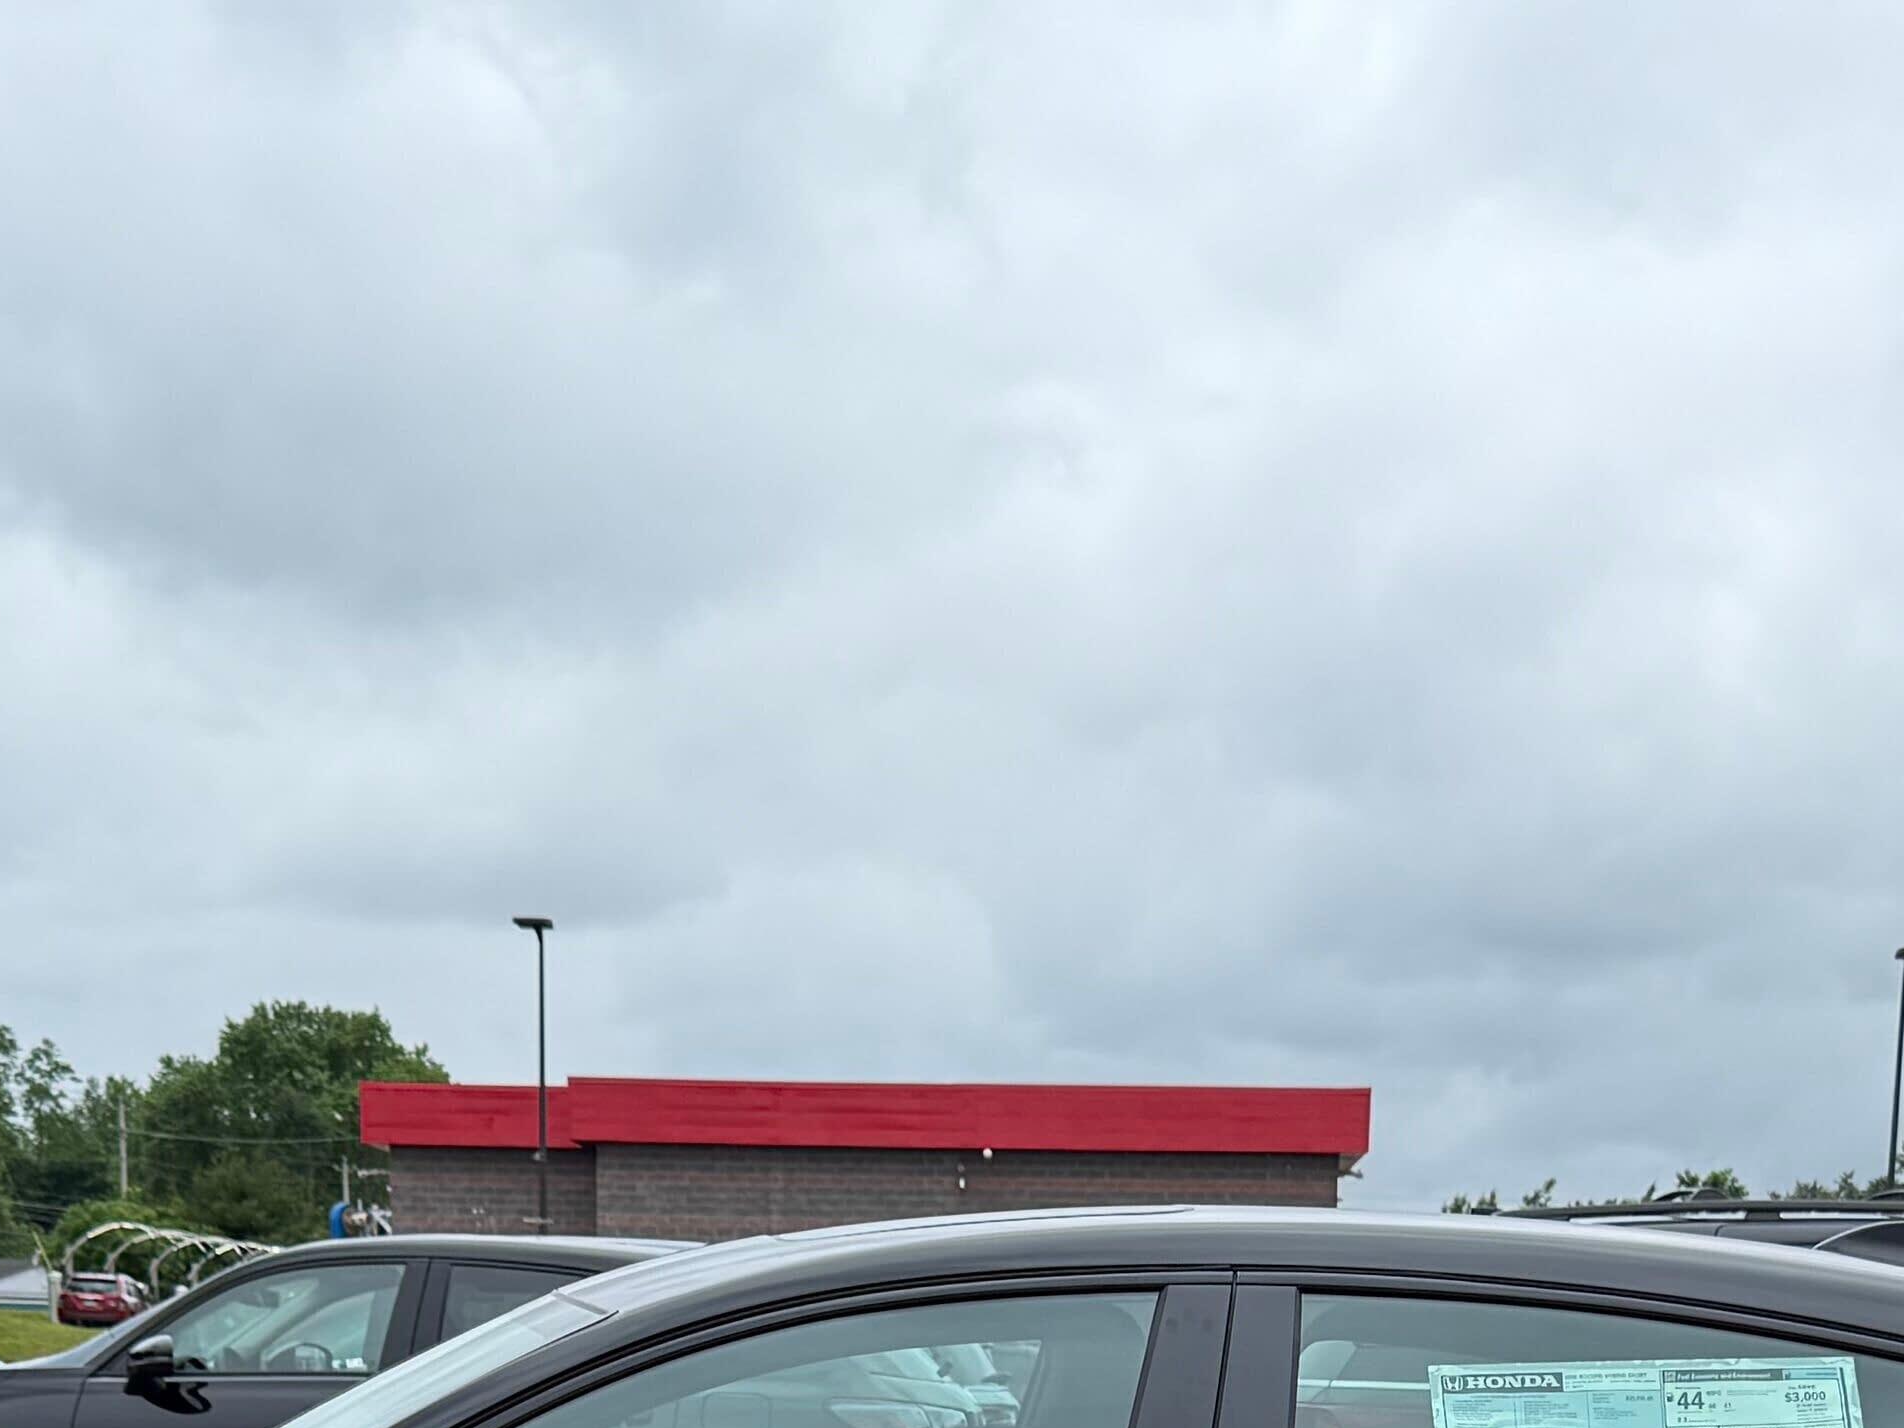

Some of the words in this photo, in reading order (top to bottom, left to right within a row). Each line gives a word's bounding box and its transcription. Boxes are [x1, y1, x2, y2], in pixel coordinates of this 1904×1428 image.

[1465, 1374, 1561, 1389] HONDA
[1677, 1391, 1705, 1409] 44
[1784, 1390, 1826, 1403] $3,000
